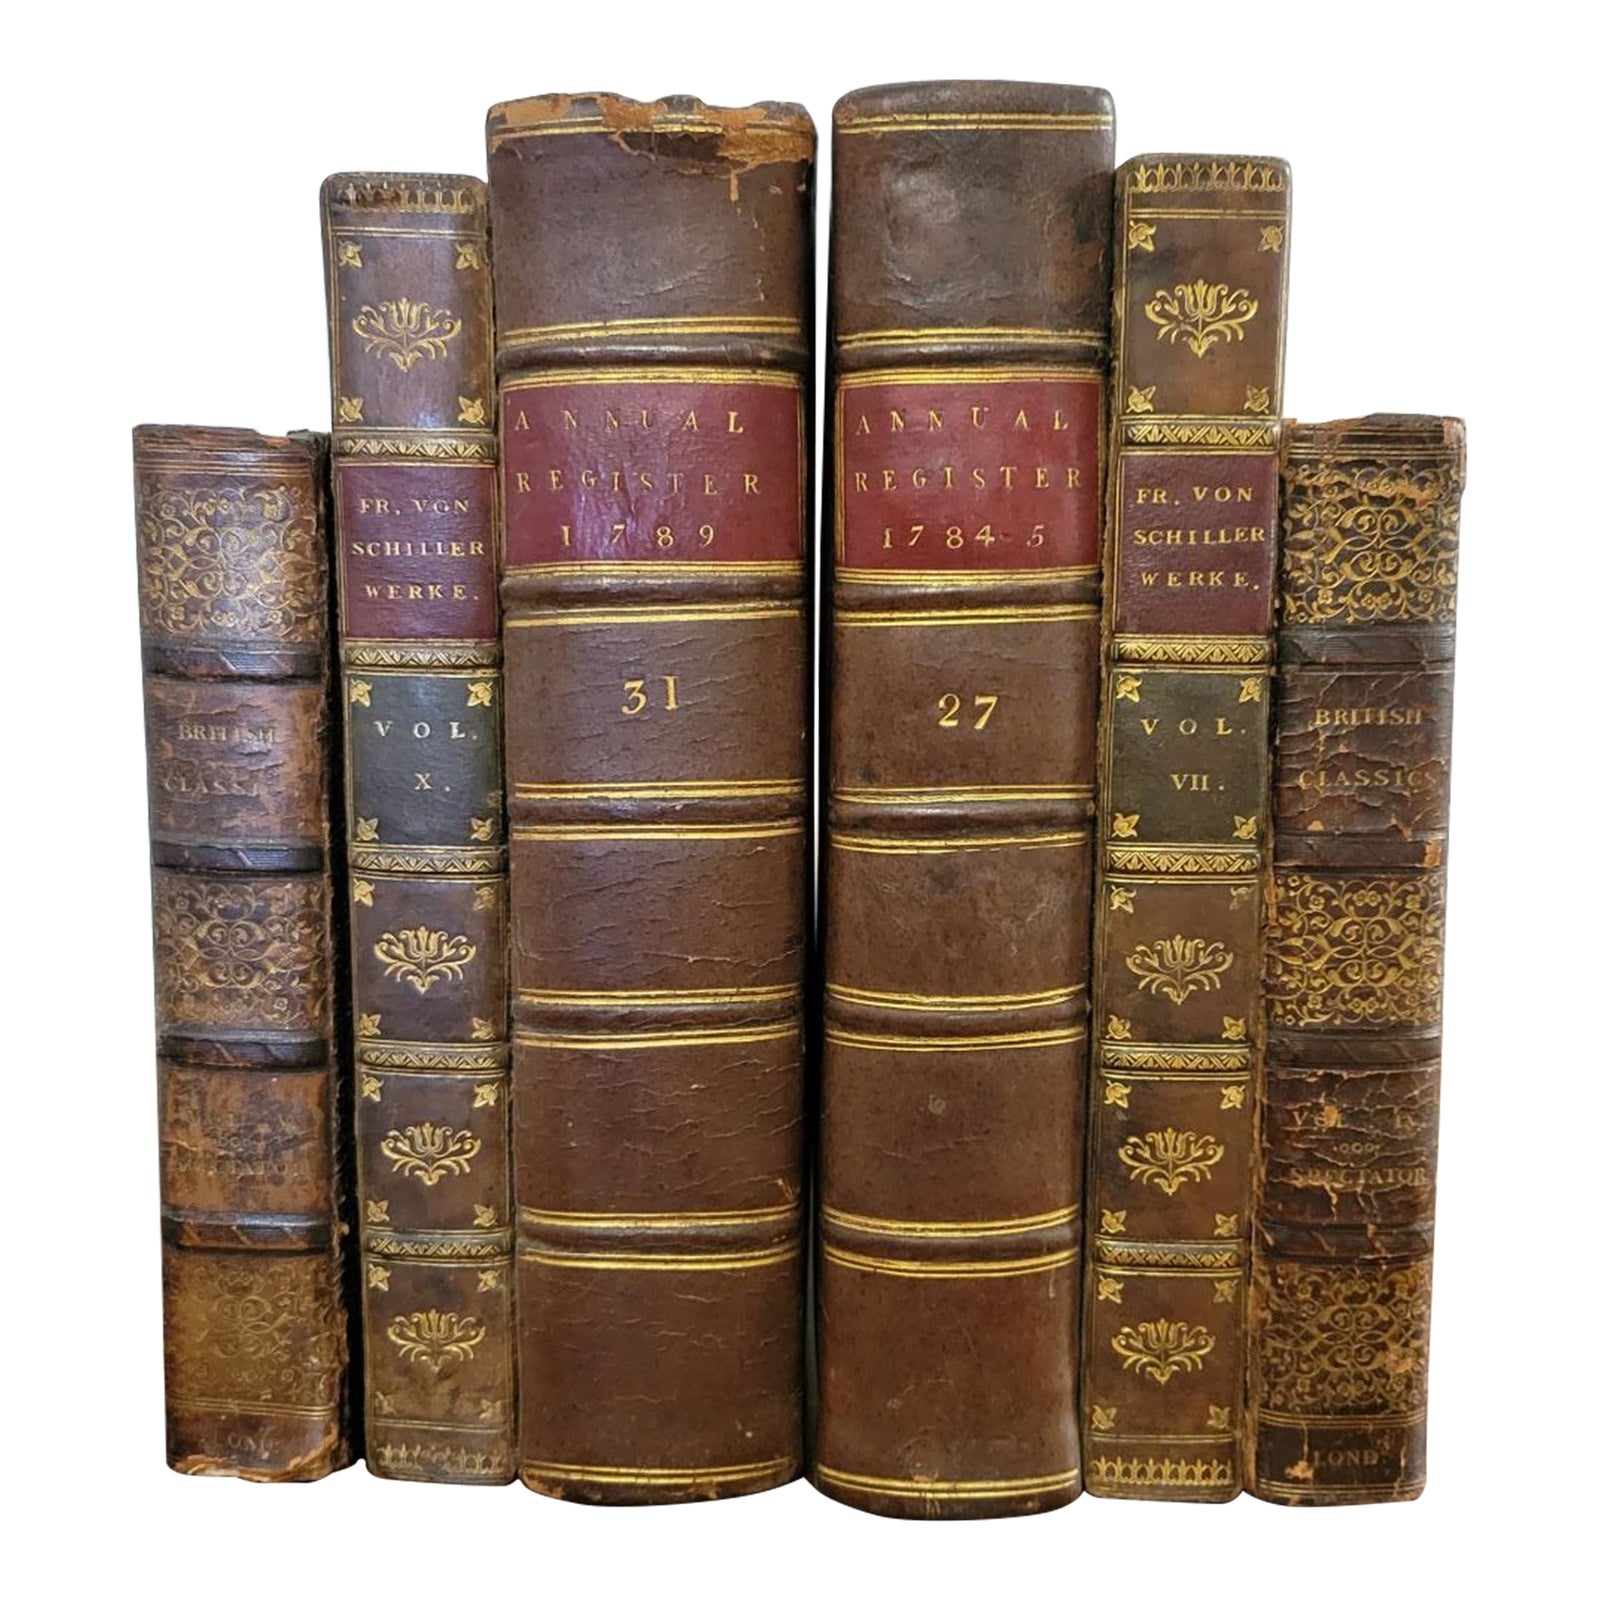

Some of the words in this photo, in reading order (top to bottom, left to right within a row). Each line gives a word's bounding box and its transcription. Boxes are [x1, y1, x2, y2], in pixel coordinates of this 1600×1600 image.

[514, 409, 744, 433] ANNUAL
[855, 406, 1069, 435] ANNUAL
[516, 469, 761, 494] REGISTER
[854, 466, 1082, 493] REGISTER
[1136, 487, 1180, 506] FR.
[1192, 486, 1253, 503] VON
[412, 498, 470, 516] VON
[561, 524, 714, 548] 1789
[1133, 526, 1266, 546] SCHILLER
[352, 541, 485, 557] SCHILLER
[1140, 571, 1260, 591] WERKE.
[364, 584, 479, 600] WERKE.
[621, 675, 680, 715] 31
[937, 693, 998, 730] 27
[1314, 707, 1423, 727] BRITISH
[373, 720, 478, 741] VOL.
[1140, 716, 1246, 736] VOL.
[413, 772, 450, 792] X.
[1170, 773, 1225, 792] VII.
[1289, 1167, 1428, 1187] SPECTATOR
